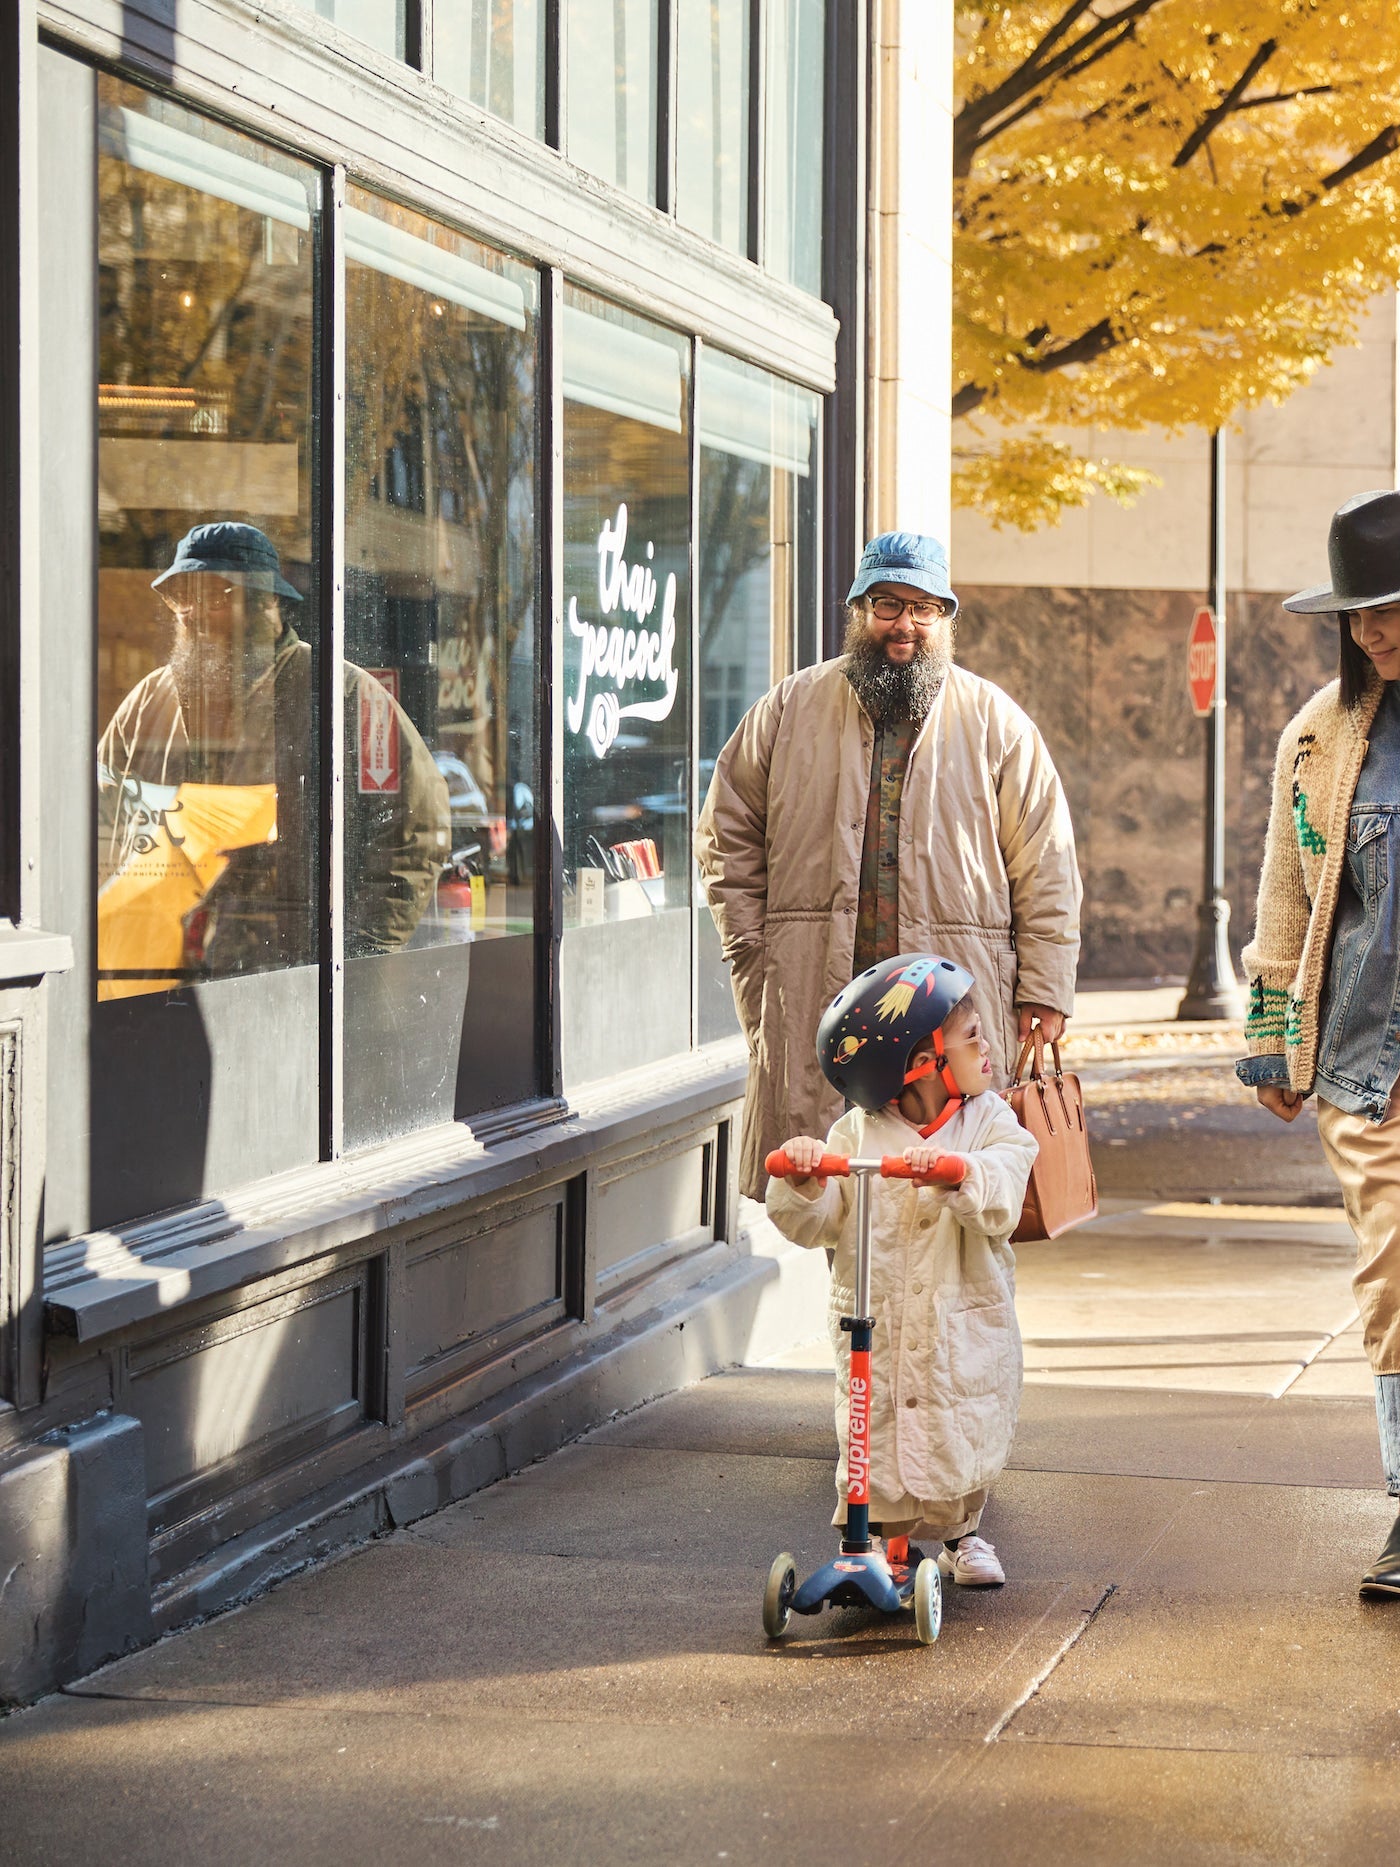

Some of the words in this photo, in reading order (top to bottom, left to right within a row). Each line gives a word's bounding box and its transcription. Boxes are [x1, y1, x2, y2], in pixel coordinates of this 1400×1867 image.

[598, 503, 656, 623] thai
[568, 572, 679, 734] peacock
[847, 1376, 870, 1496] Supreme
